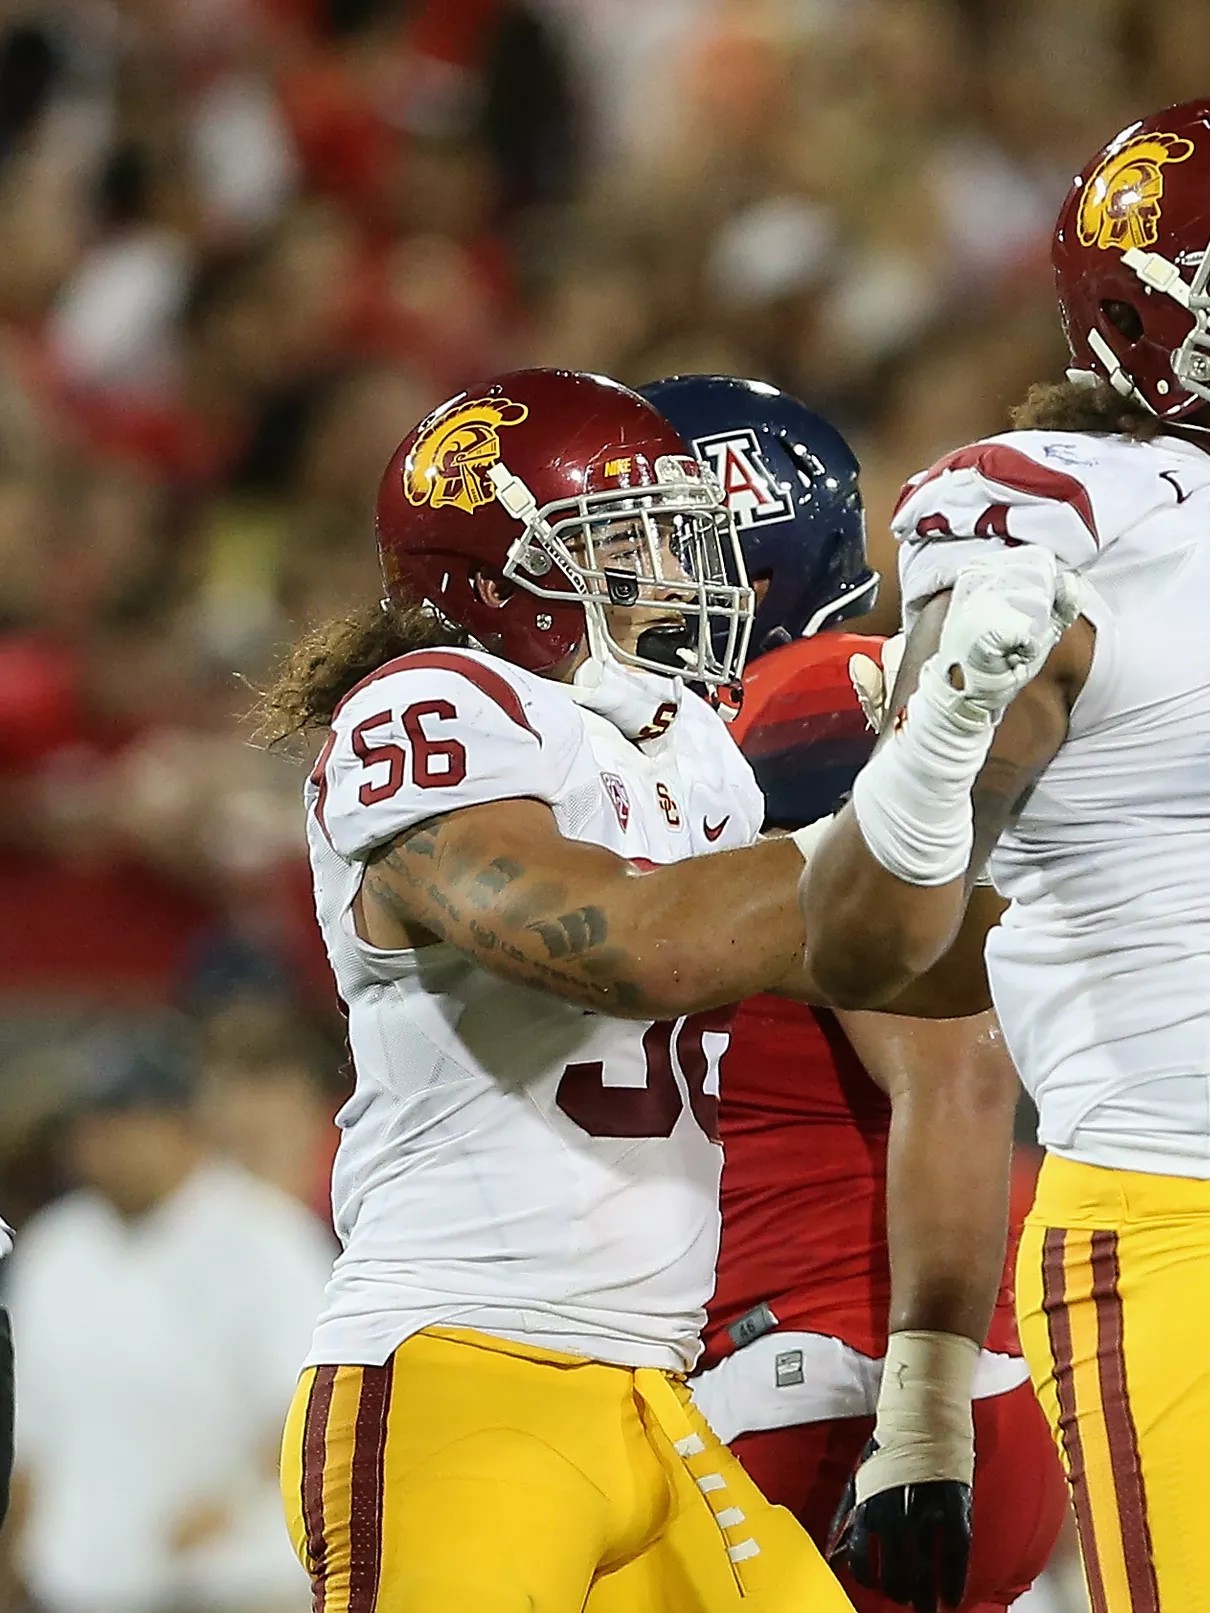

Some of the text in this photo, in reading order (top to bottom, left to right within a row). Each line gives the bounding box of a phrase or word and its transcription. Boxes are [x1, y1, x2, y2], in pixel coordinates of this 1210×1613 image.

[604, 458, 631, 477] NIKE
[693, 429, 795, 534] A
[352, 699, 468, 807] 56
[656, 781, 680, 826] SC
